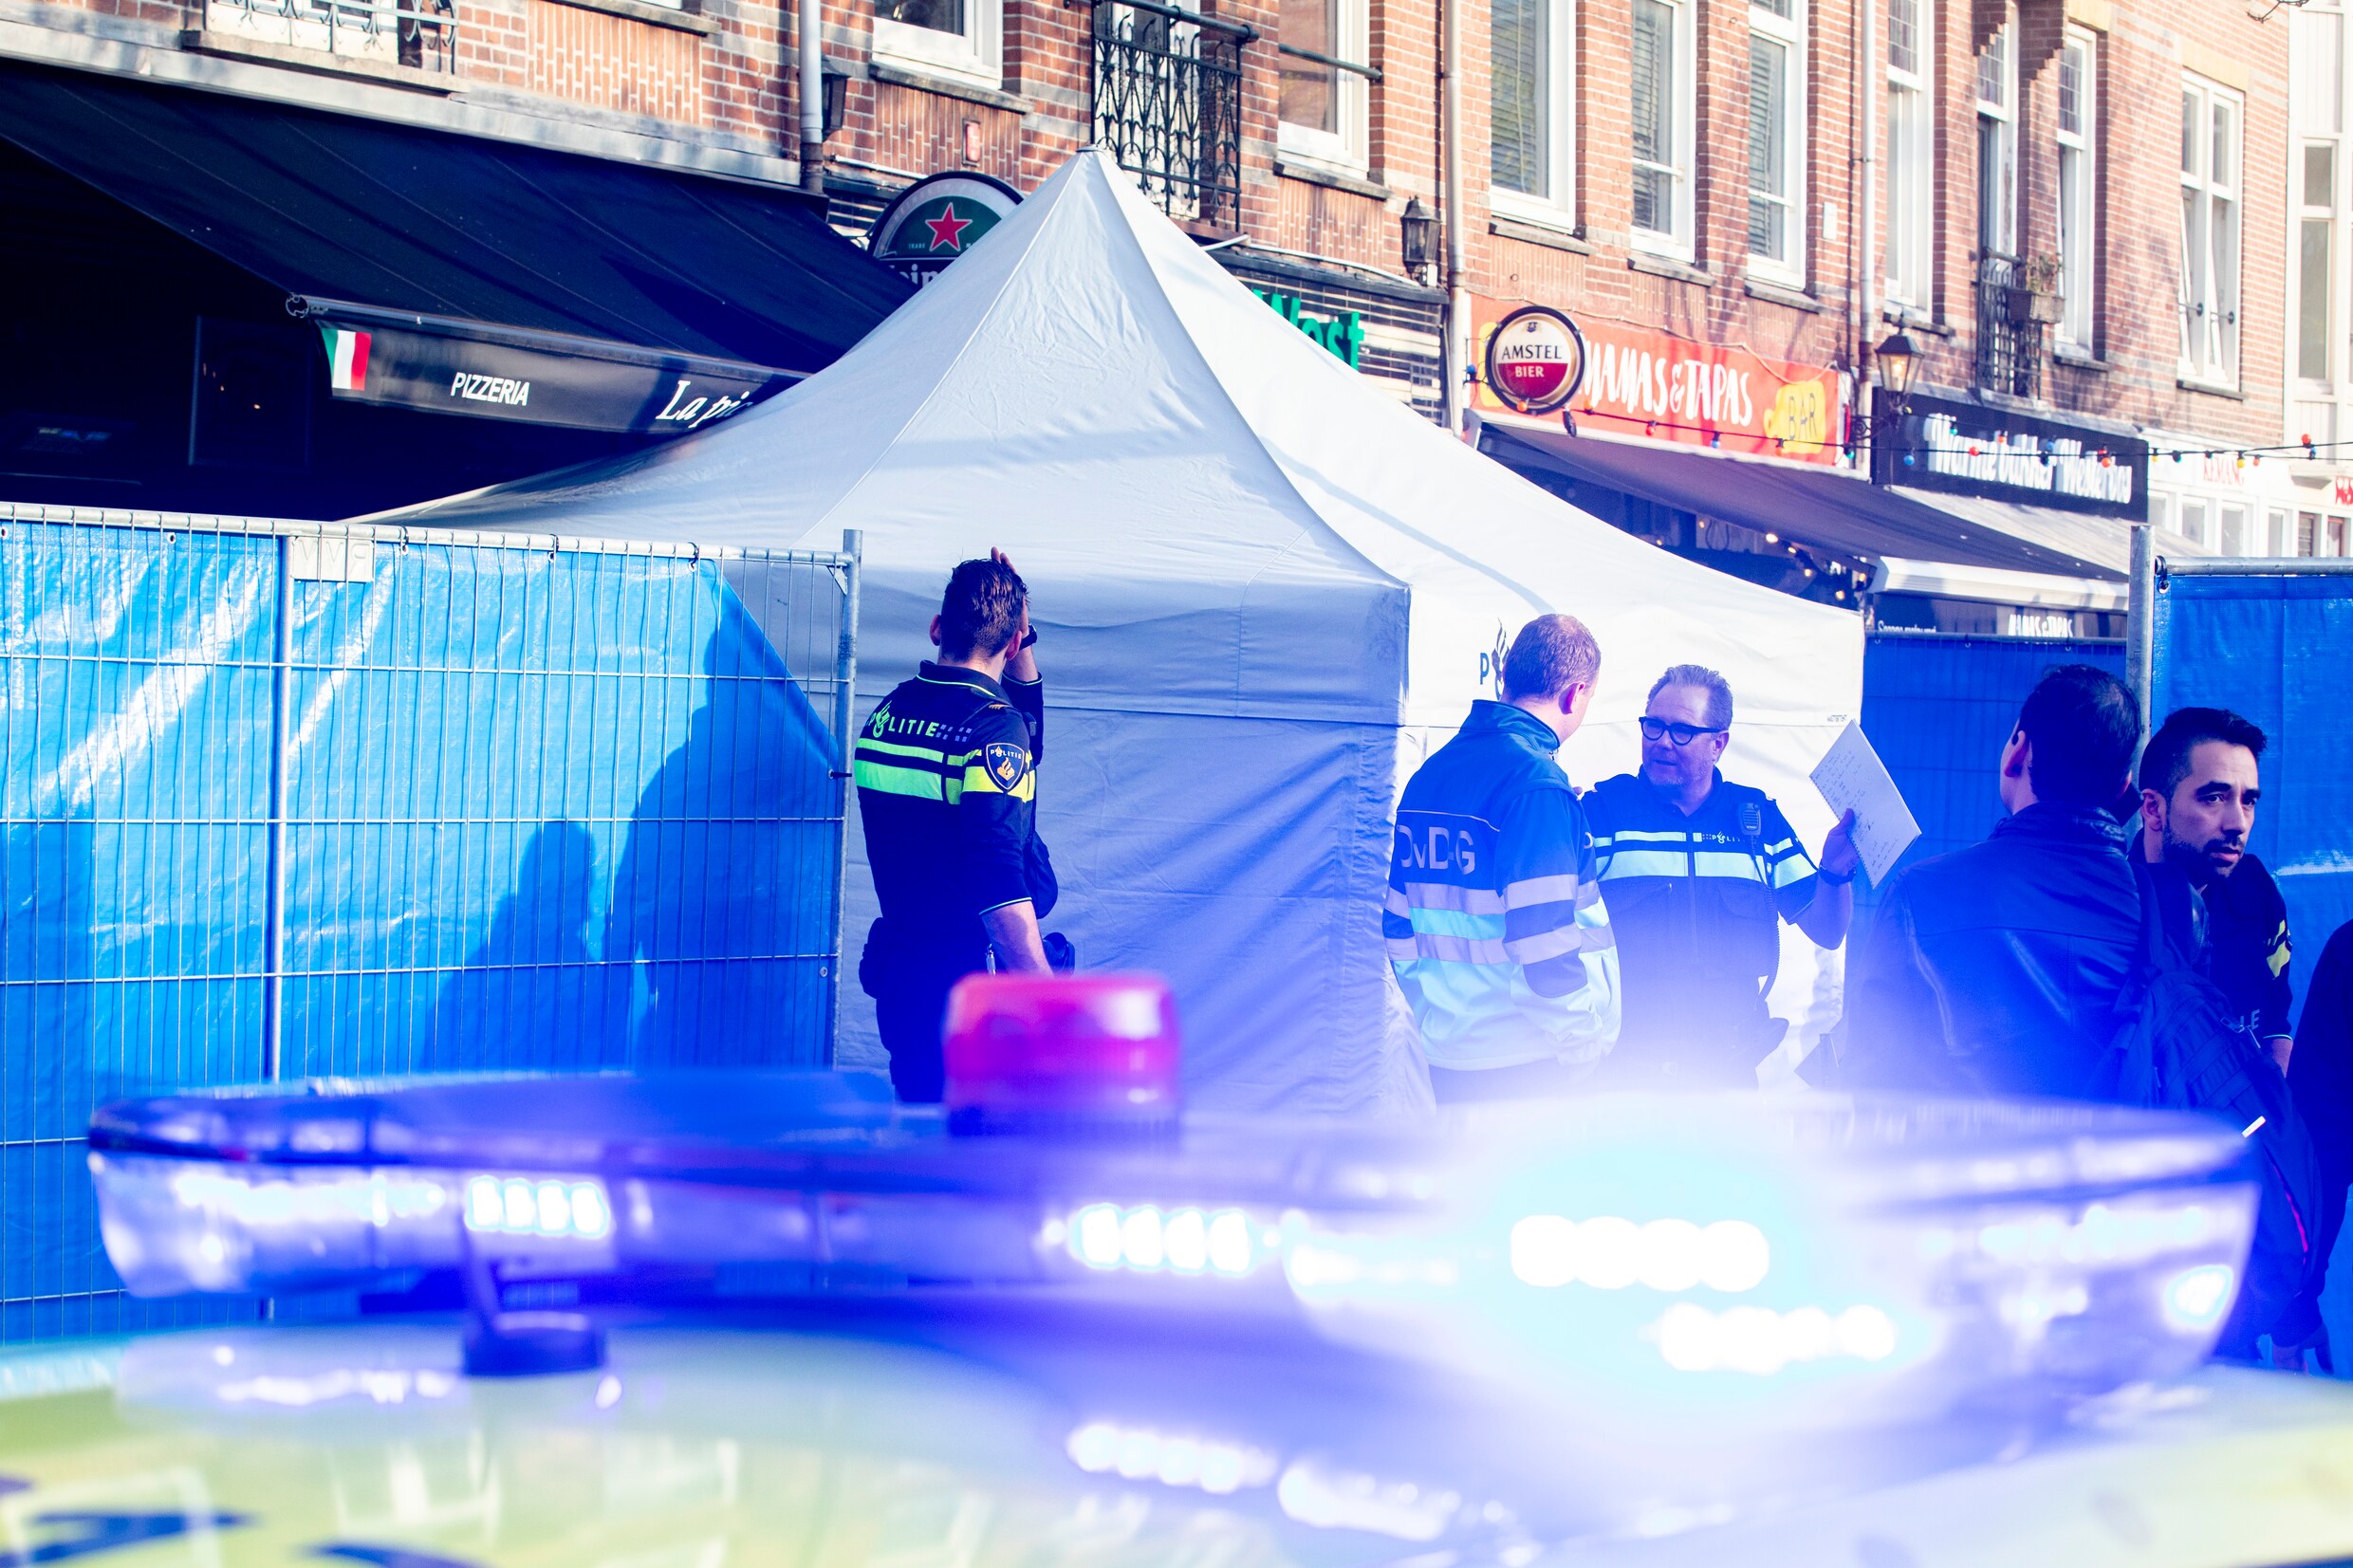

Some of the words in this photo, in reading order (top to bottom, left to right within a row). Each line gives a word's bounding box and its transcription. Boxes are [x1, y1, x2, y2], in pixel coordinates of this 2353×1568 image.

[1501, 344, 1563, 360] AMSTEL
[1514, 365, 1545, 378] BIER
[450, 372, 530, 406] PIZZERIA
[656, 379, 708, 421] La
[1788, 392, 1818, 440] BAR
[990, 746, 1023, 760] POLITIE
